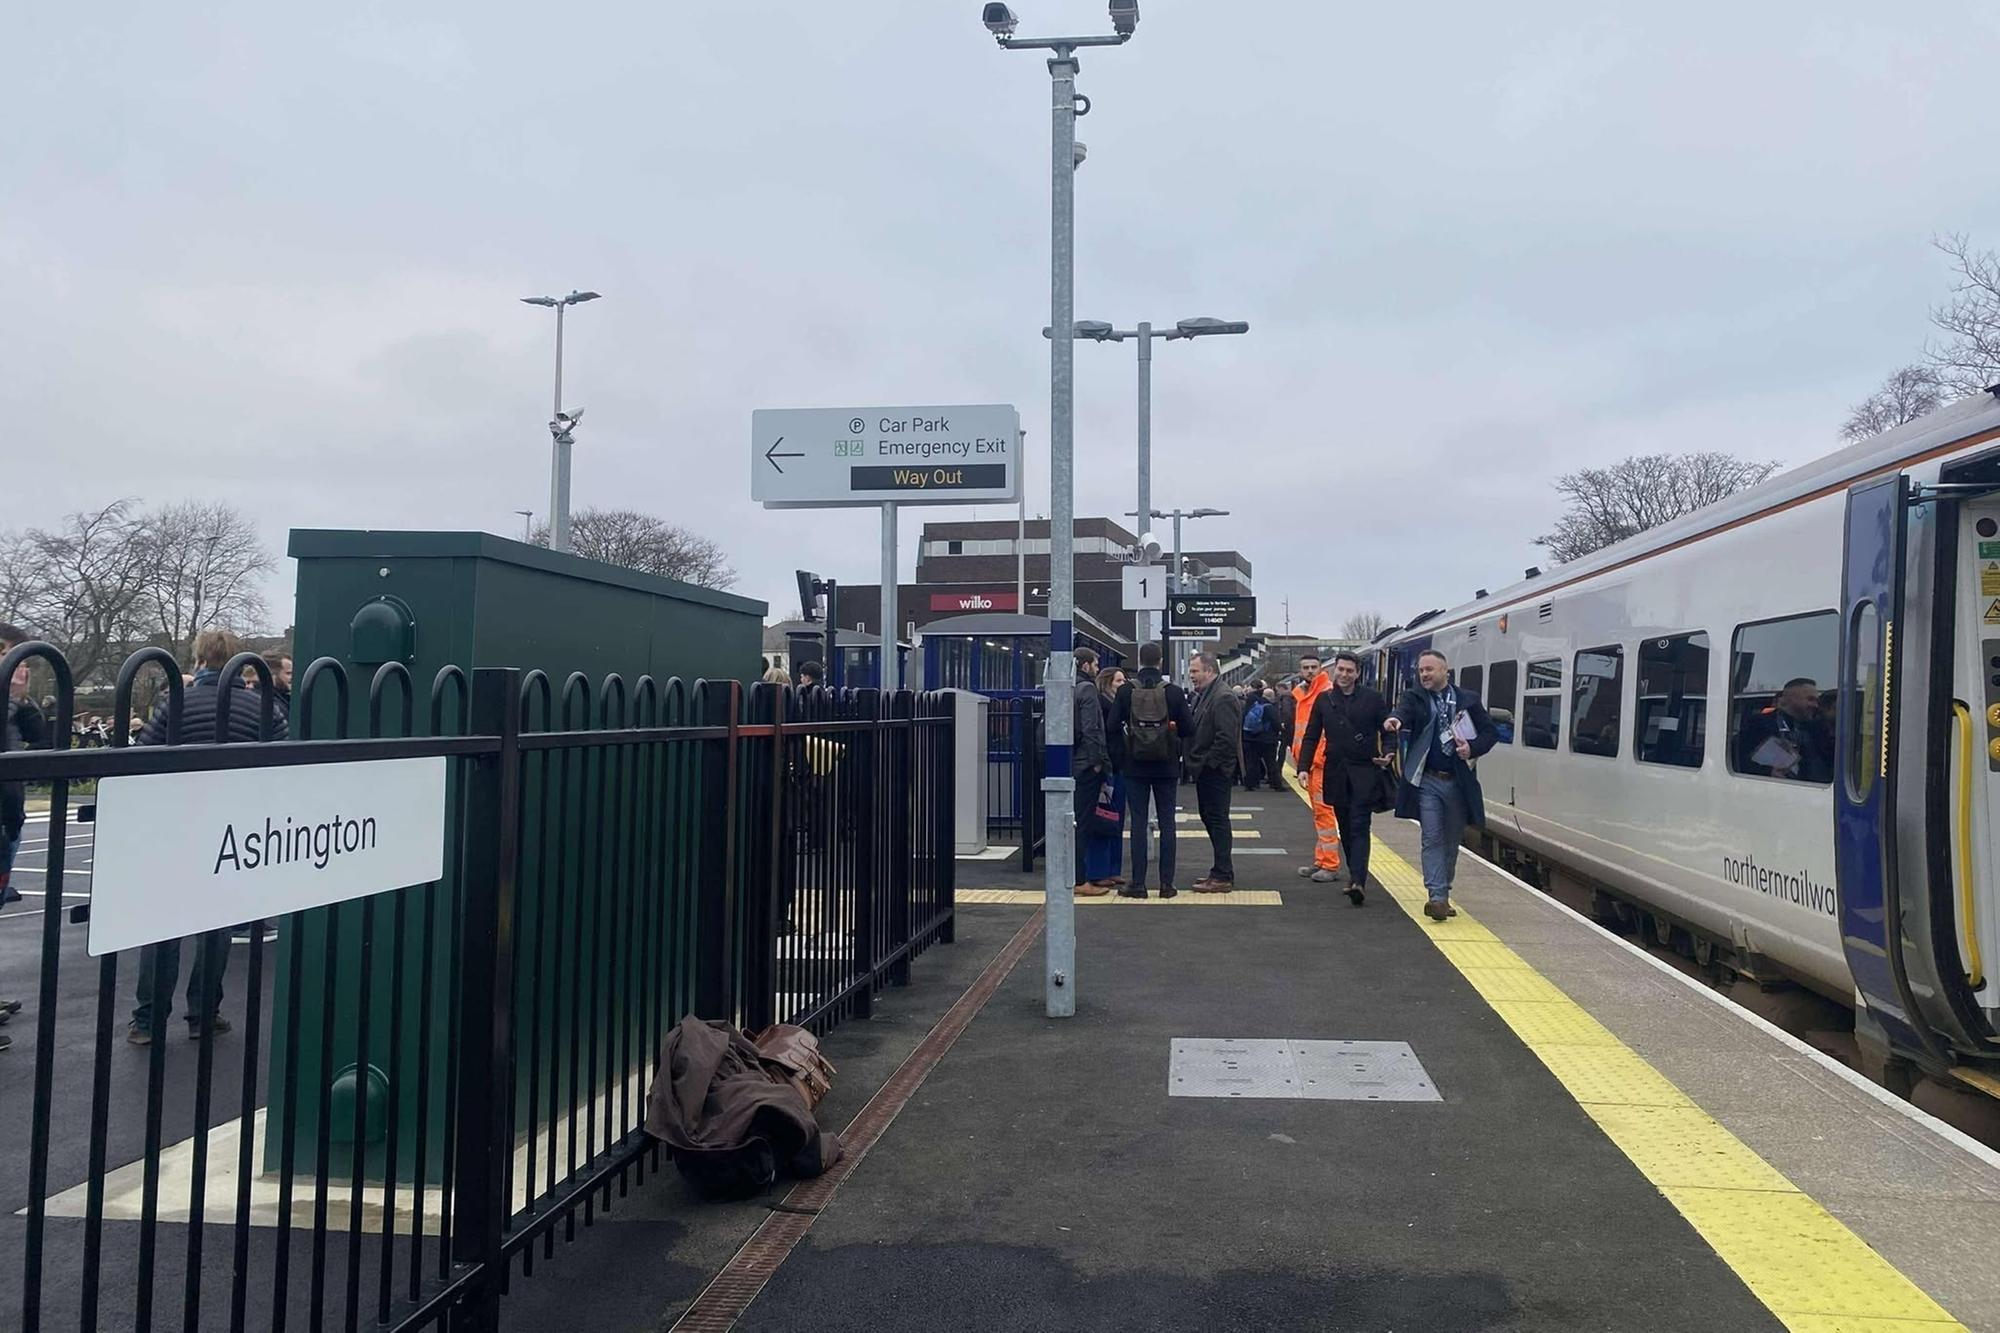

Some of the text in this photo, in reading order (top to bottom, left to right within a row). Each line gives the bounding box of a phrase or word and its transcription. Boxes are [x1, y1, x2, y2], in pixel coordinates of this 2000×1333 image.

[879, 418, 907, 433] Car
[913, 416, 950, 432] Park
[879, 438, 1006, 457] Emergency Exit
[893, 469, 962, 488] Way Out
[1139, 578, 1147, 598] 1
[959, 595, 992, 609] wilko
[213, 814, 377, 875] Ashington
